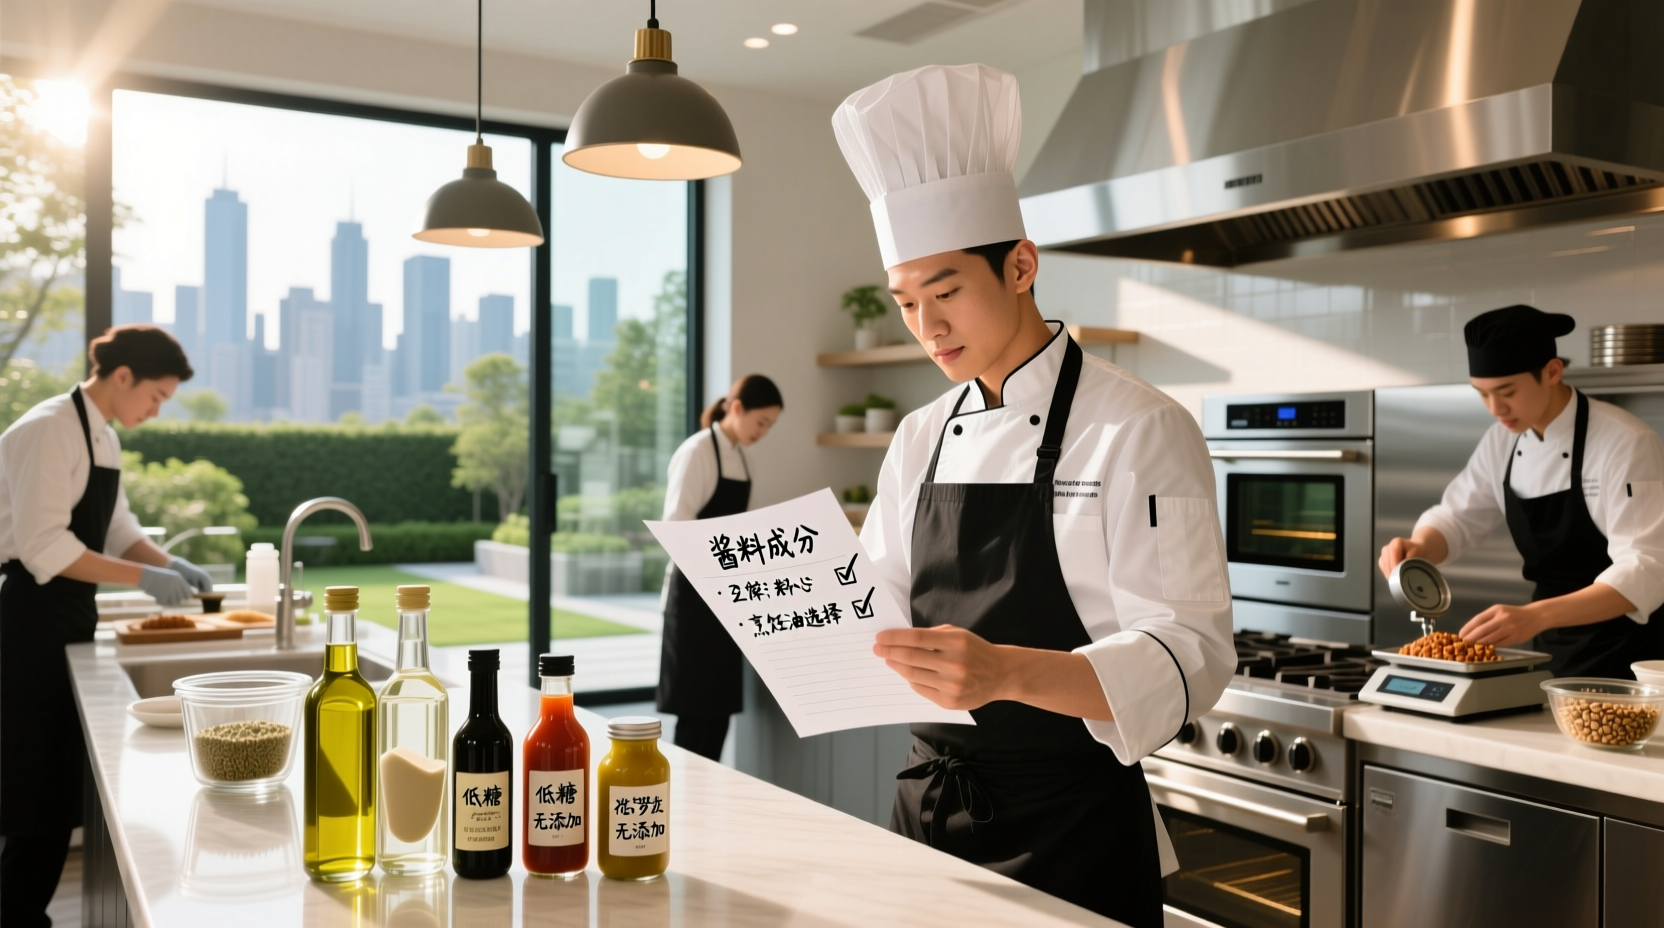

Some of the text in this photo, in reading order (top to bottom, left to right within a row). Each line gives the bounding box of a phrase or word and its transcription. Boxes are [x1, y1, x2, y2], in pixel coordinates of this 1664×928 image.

[709, 524, 819, 570] 酱料成分
[462, 784, 502, 807] 低糖
[535, 781, 577, 804] 低糖
[533, 812, 581, 831] 无添加
[615, 821, 665, 840] 无添加
